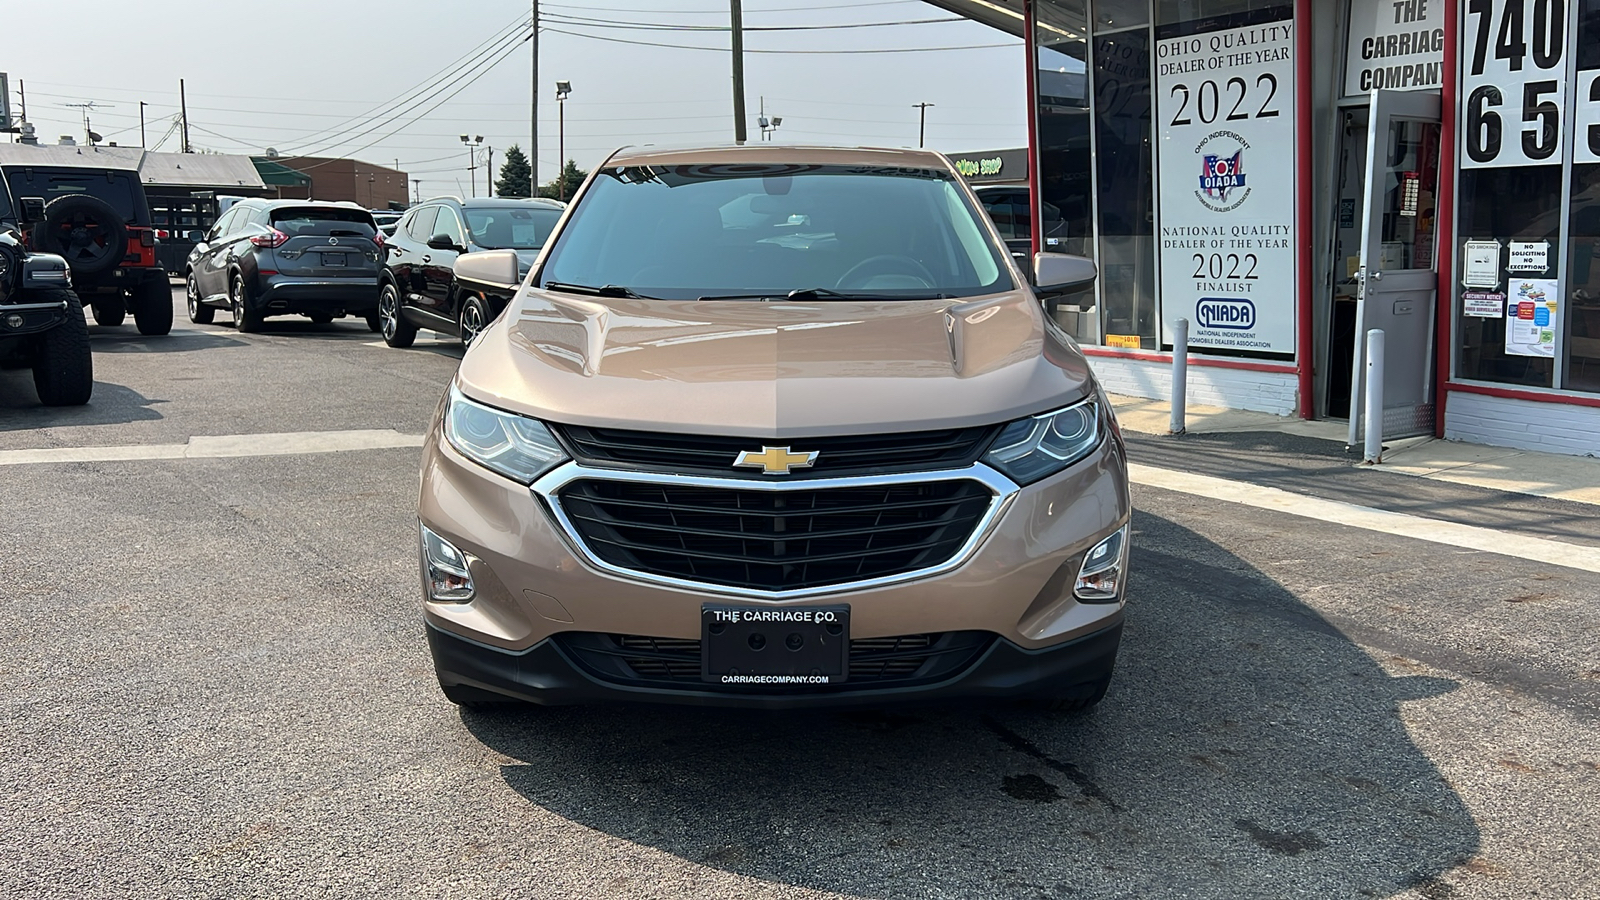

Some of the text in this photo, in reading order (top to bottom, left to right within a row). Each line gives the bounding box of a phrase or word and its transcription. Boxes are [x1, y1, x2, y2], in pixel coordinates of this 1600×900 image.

[1393, 0, 1427, 24] THE
[1158, 24, 1292, 58] OHIO QUALITY
[1361, 28, 1443, 60] CARRIAG
[1469, 0, 1564, 75] 740
[1160, 47, 1289, 76] DEALER OF THE YEAR
[1170, 73, 1279, 126] 2022
[1194, 131, 1251, 154] OHIO INDEPENDENT
[980, 157, 1002, 175] SHOP
[1205, 175, 1238, 188] OIADA
[1194, 190, 1214, 210] AUTOMOBILE
[1231, 187, 1252, 210] ASSOCIATION
[1162, 225, 1290, 237] NATIONAL QUALITY
[1164, 239, 1289, 248] DEALER OF THE YEAR
[1192, 253, 1259, 280] 2022
[1197, 282, 1253, 293] FINALIST
[1201, 304, 1250, 323] NIADA
[1196, 330, 1256, 339] NATIONAL INDEPENDENT
[1214, 338, 1236, 346] DEALERS
[1236, 340, 1271, 348] ASSOCIATION
[714, 610, 837, 622] THE CARRIAGE CO.
[721, 675, 829, 684] CARRIAGECOMPANY.COM
